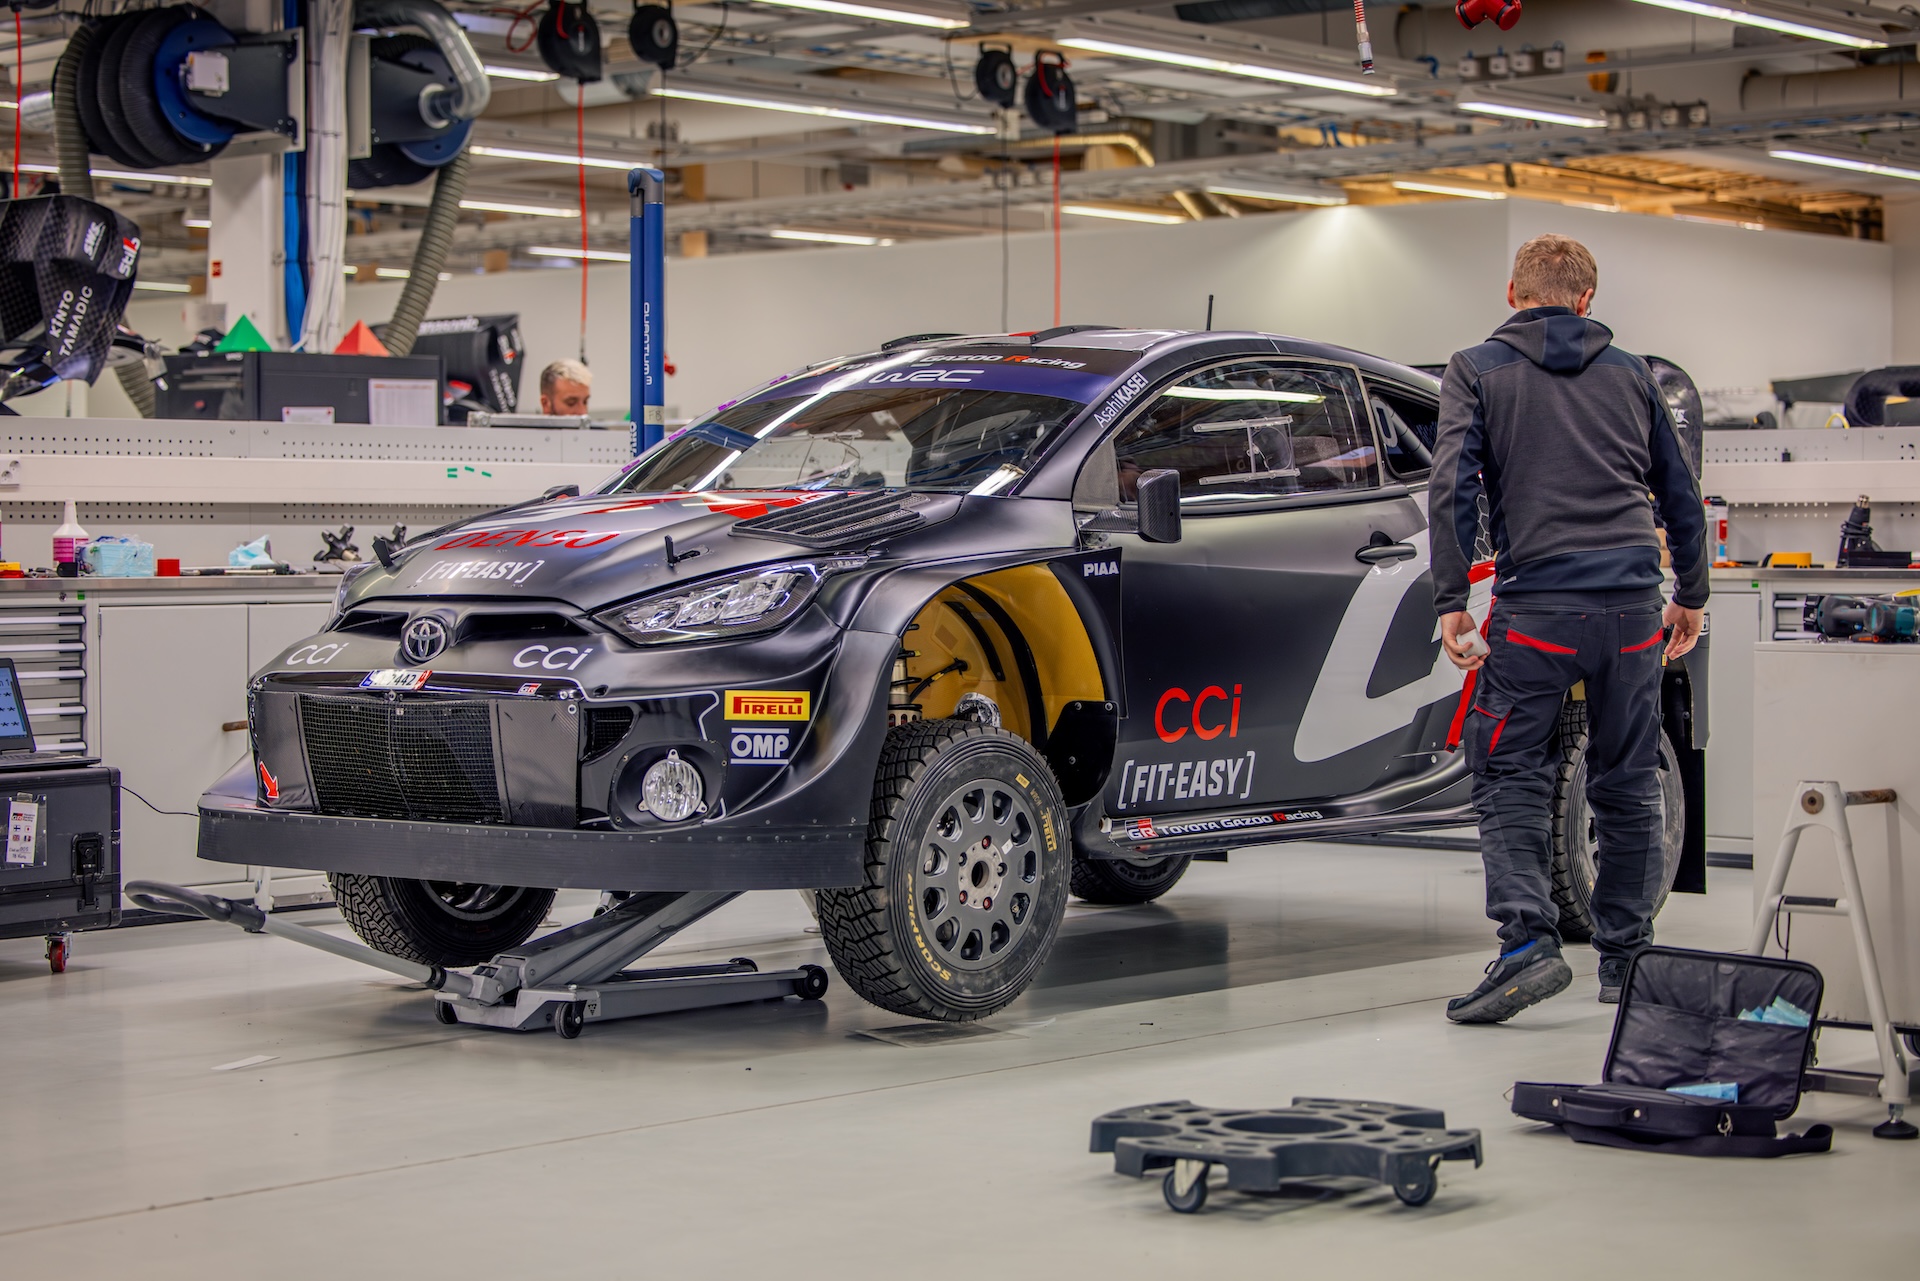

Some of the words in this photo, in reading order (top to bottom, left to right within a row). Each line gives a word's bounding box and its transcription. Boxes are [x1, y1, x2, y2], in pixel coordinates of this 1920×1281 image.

[49, 289, 75, 338] KINTO
[59, 285, 94, 356] TAMADIC
[1003, 354, 1088, 370] Racing
[868, 369, 985, 384] WRC
[1093, 371, 1149, 429] AsahiKASEI
[433, 529, 622, 551] DENSO
[1083, 561, 1120, 577] PIAA
[286, 642, 350, 666] CCi
[512, 644, 594, 671] CCi
[732, 696, 804, 715] PIRELLI
[1154, 683, 1243, 744] CCi
[730, 733, 790, 758] OMP
[1127, 826, 1159, 840] GR
[1156, 821, 1222, 836] TOYOTA
[1219, 815, 1274, 829] GAZOO
[1272, 810, 1324, 823] Racing
